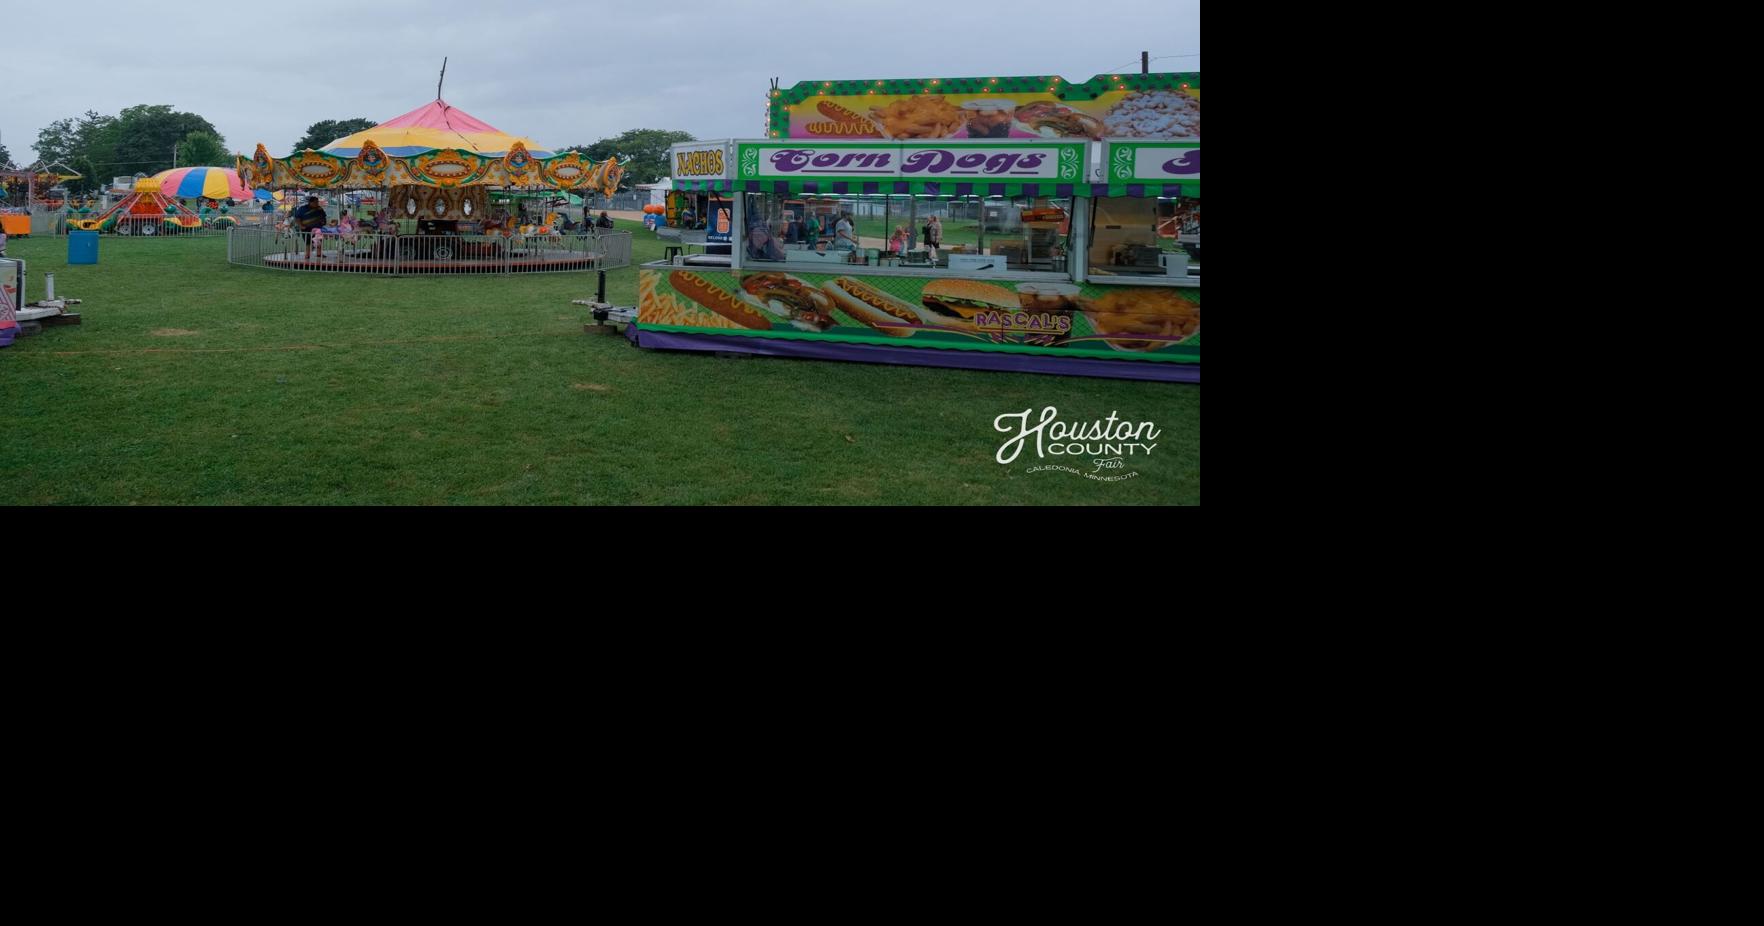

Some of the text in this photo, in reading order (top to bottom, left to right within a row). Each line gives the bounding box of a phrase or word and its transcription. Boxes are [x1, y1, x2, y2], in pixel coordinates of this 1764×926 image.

[677, 149, 724, 176] NACHOS
[770, 149, 1047, 174] Corn Dogs
[975, 311, 1071, 332] RASCAL'S
